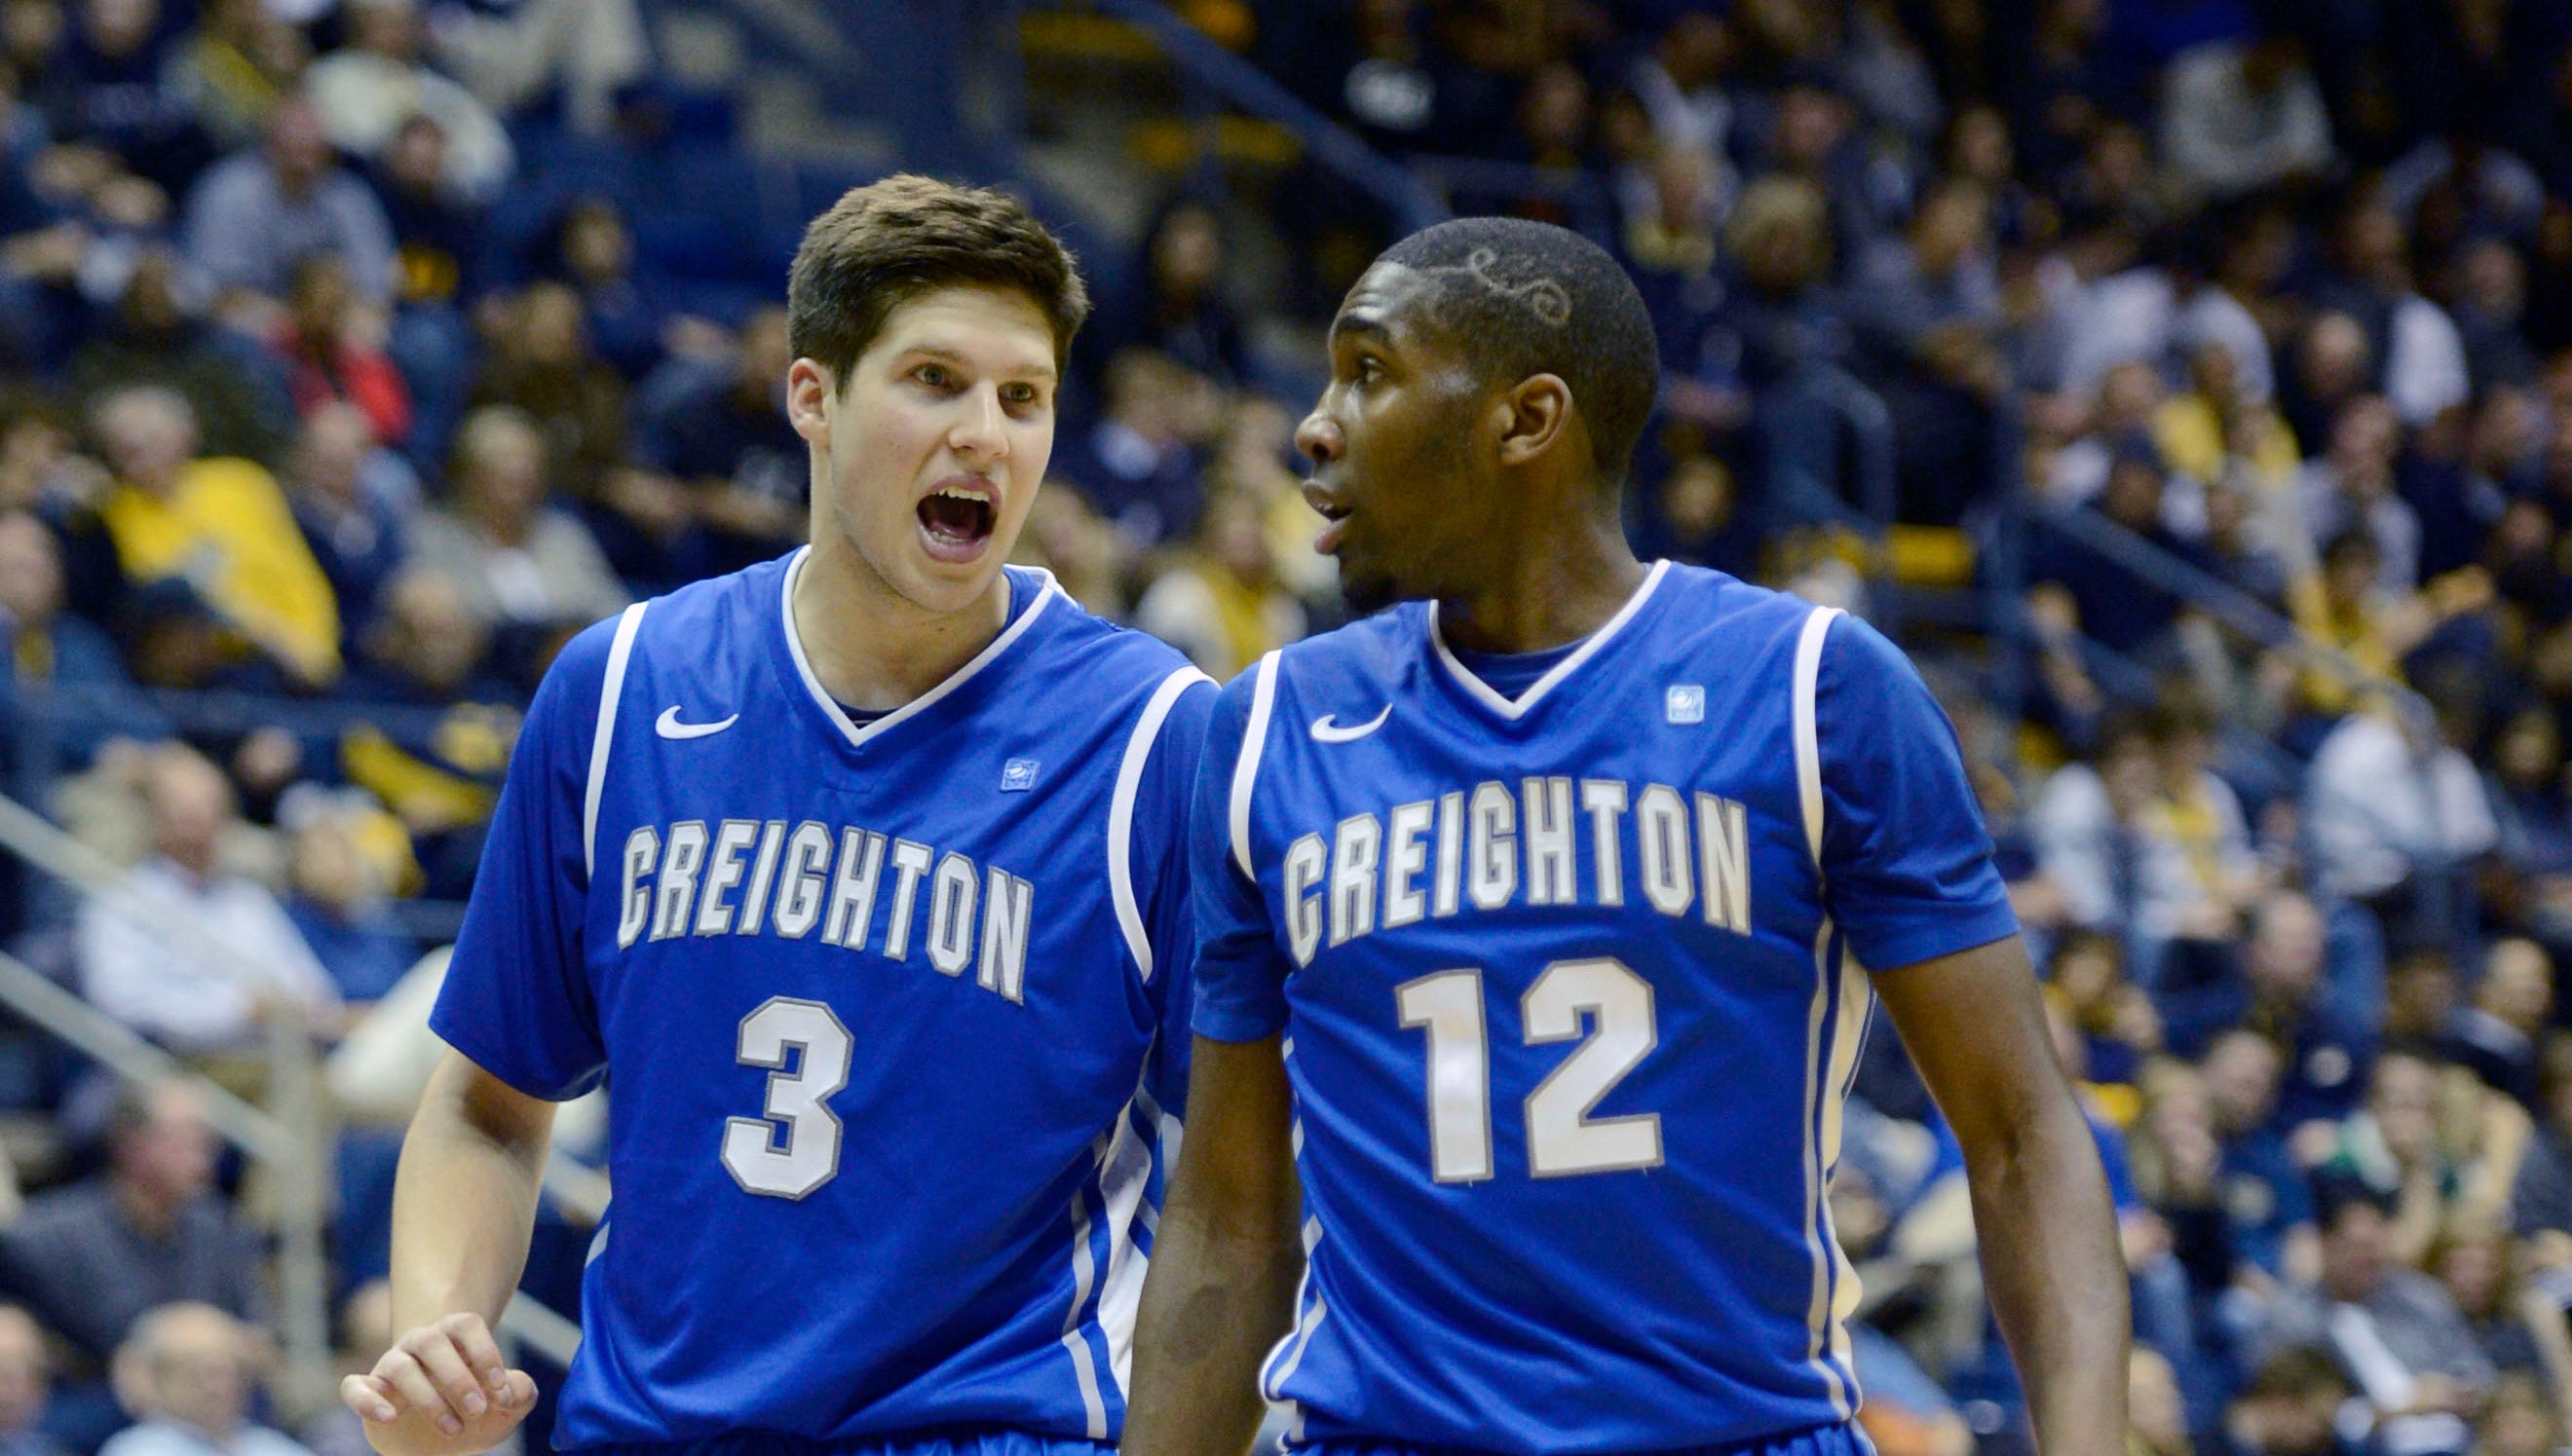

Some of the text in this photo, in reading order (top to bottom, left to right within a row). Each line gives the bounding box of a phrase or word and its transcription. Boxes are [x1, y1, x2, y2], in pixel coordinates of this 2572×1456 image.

[617, 819, 1035, 1006] CREIGHTON
[1283, 776, 1752, 969] CREIGHTON
[720, 995, 854, 1201] 3
[1394, 956, 1665, 1183] 12
